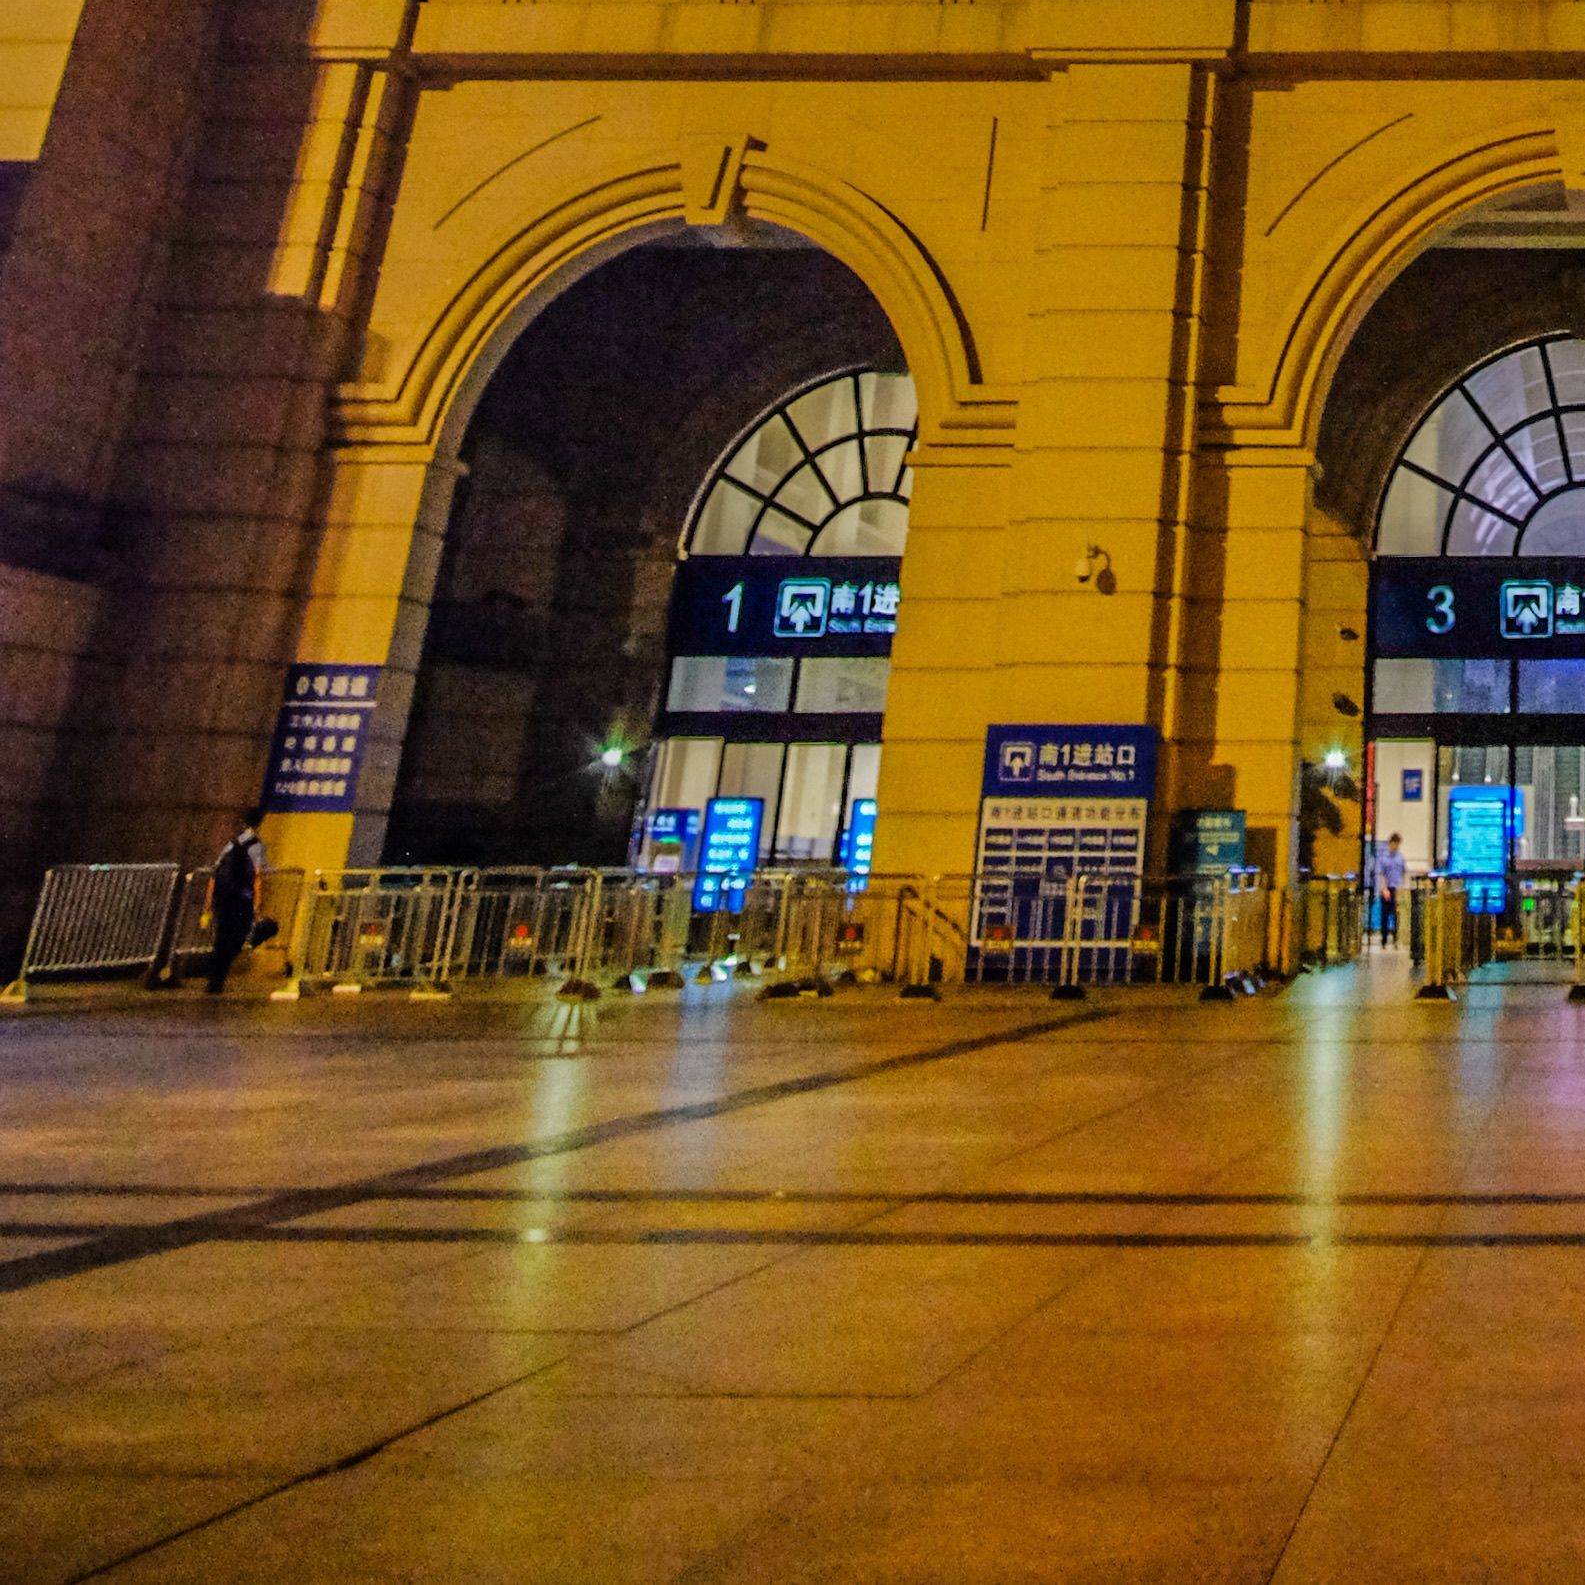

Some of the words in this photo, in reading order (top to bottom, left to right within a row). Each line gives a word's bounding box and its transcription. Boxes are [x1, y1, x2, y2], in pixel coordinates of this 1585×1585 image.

[722, 581, 744, 633] 1
[1426, 584, 1456, 634] 3
[1039, 742, 1136, 767] 南1进站口
